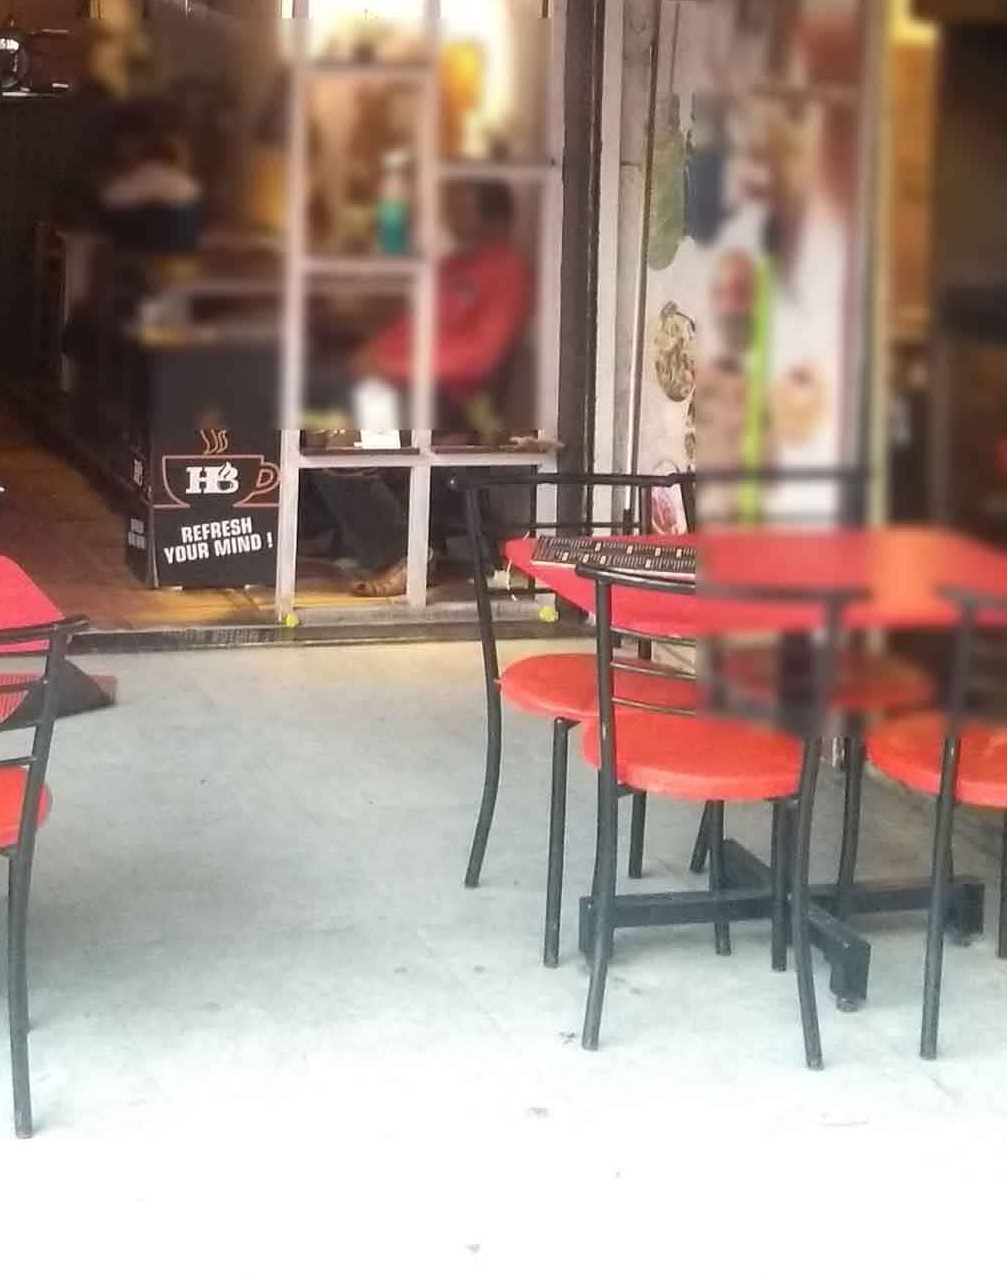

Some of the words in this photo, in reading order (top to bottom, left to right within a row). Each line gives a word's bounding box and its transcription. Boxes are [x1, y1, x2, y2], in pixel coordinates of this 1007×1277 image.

[186, 462, 239, 494] HB
[182, 518, 252, 542] REFRESH
[164, 543, 209, 564] YOUR
[215, 535, 262, 556] MIND
